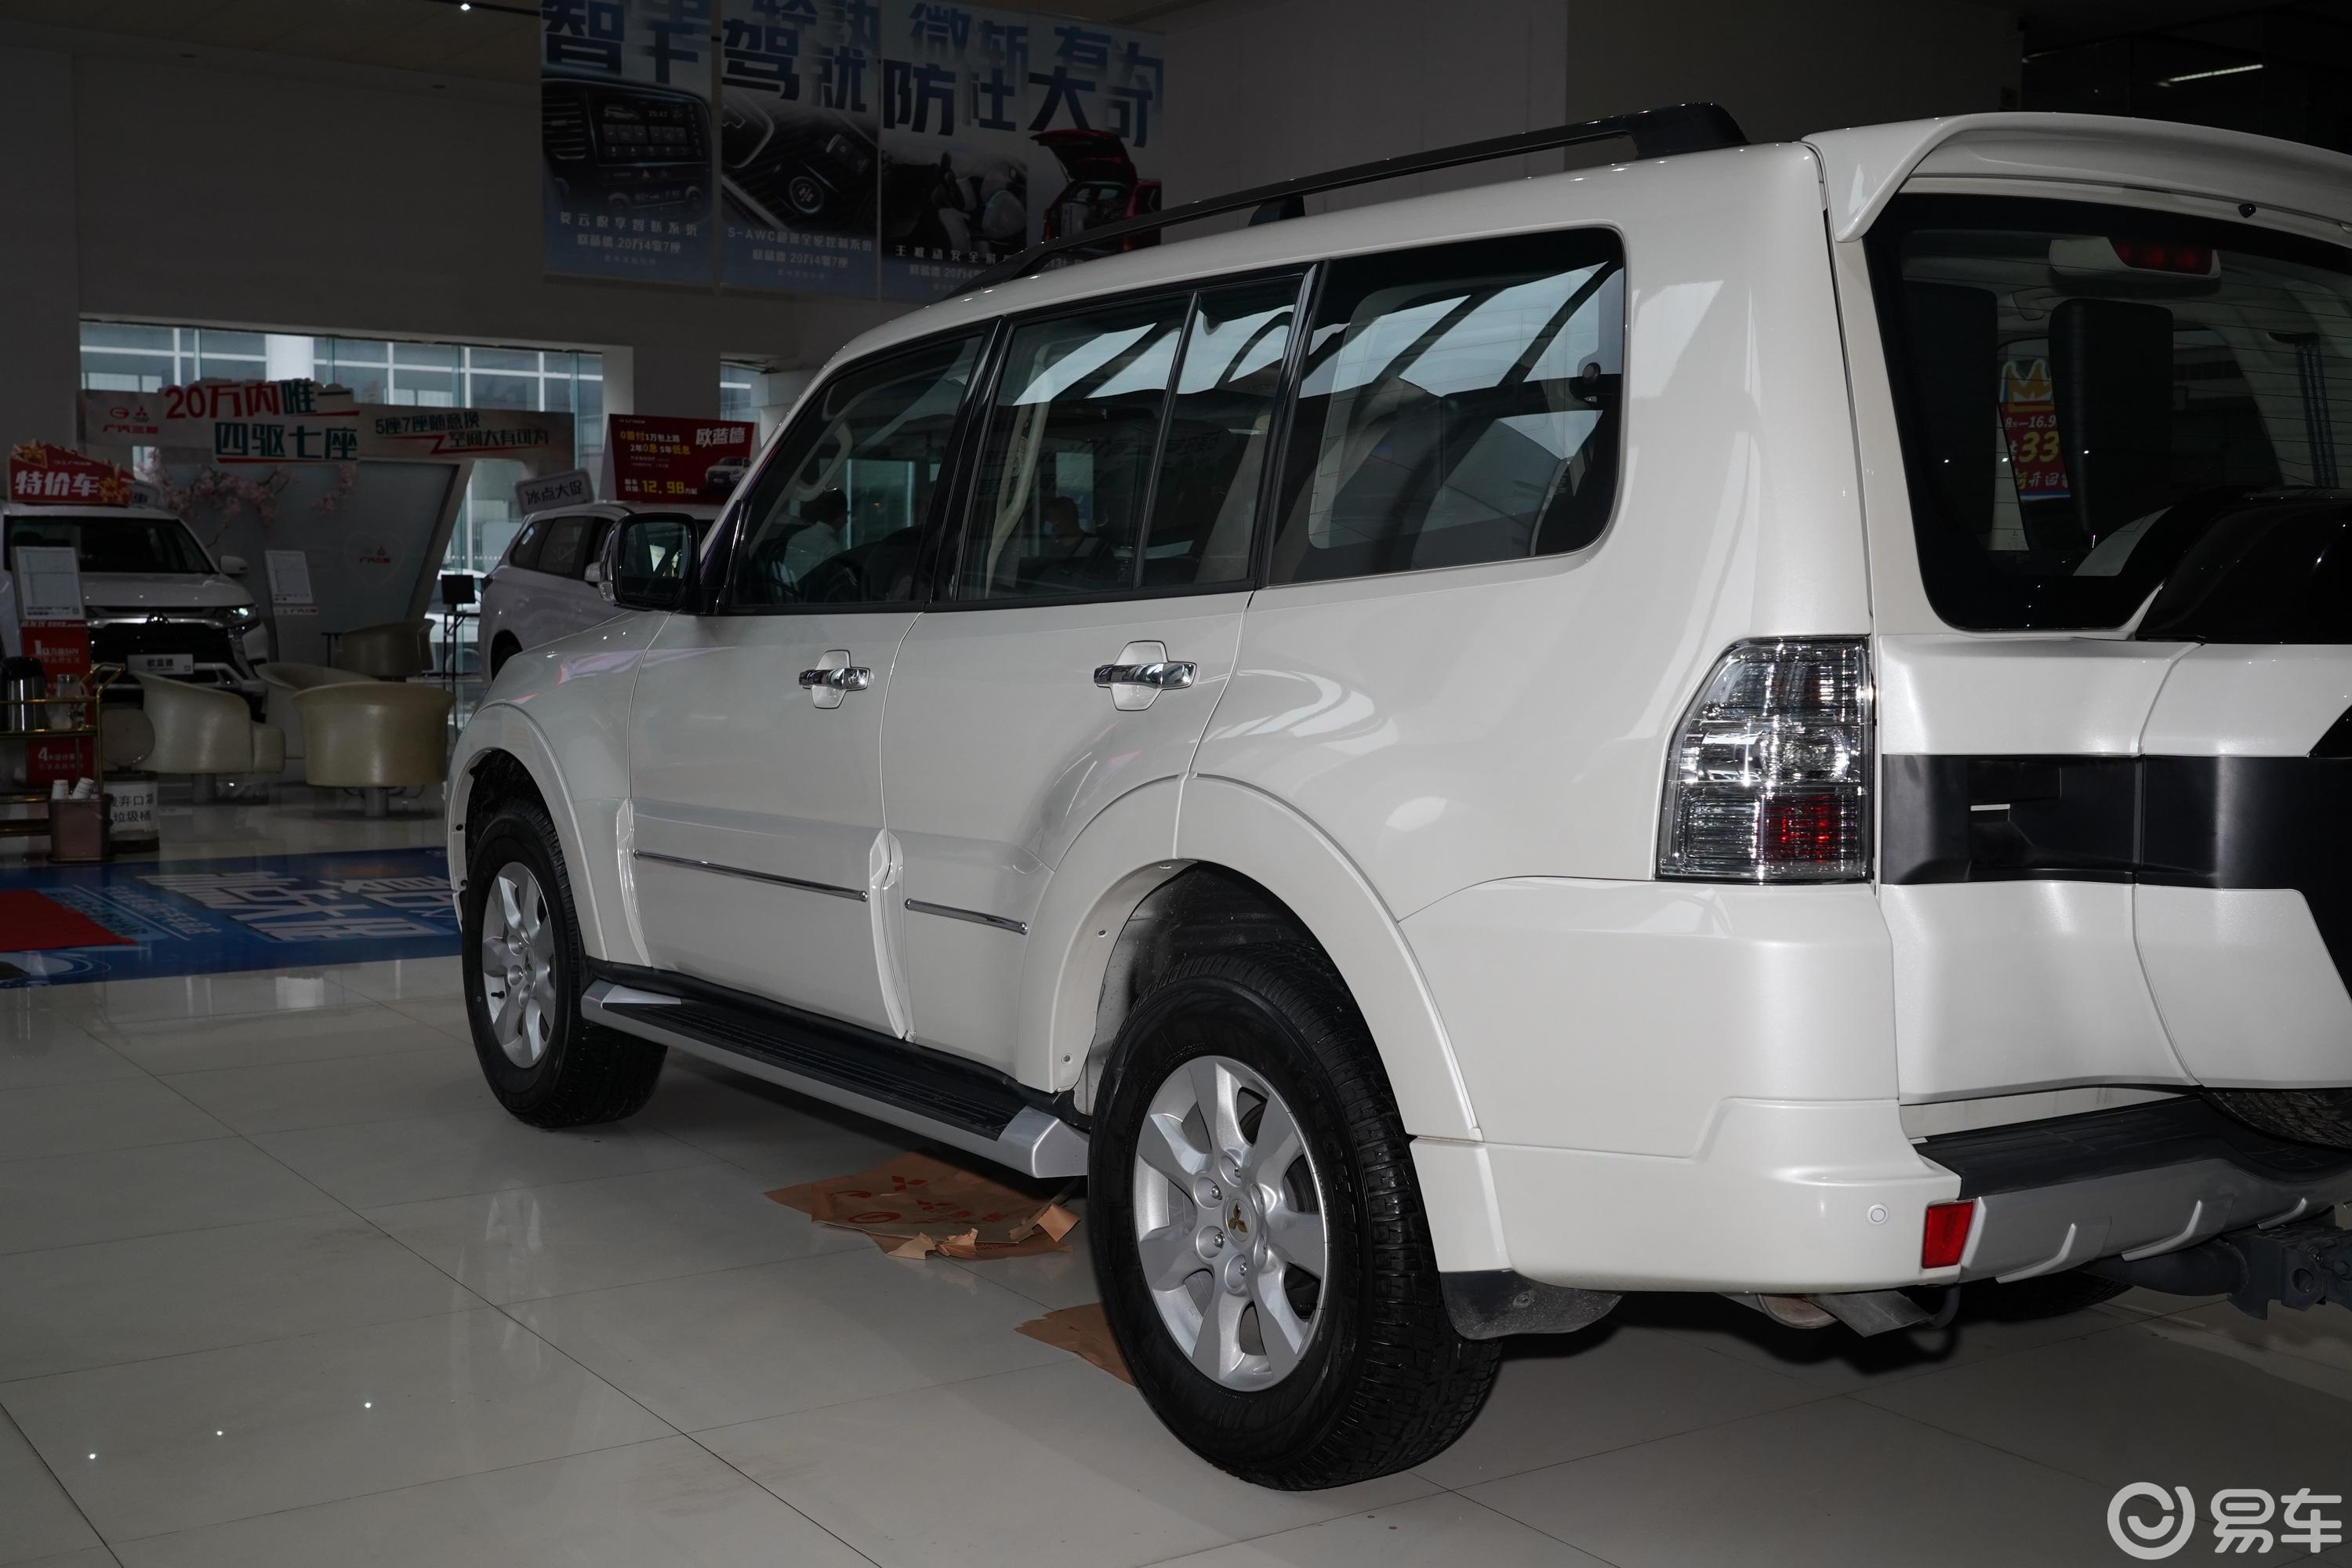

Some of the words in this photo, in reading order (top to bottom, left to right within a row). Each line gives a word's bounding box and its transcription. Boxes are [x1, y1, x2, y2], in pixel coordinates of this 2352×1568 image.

[164, 378, 352, 419] 20万内唯一
[215, 422, 358, 461] 四驱七座
[695, 427, 746, 448] 欧蓝德
[15, 470, 100, 497] 特价车
[525, 479, 584, 506] 冰点大促
